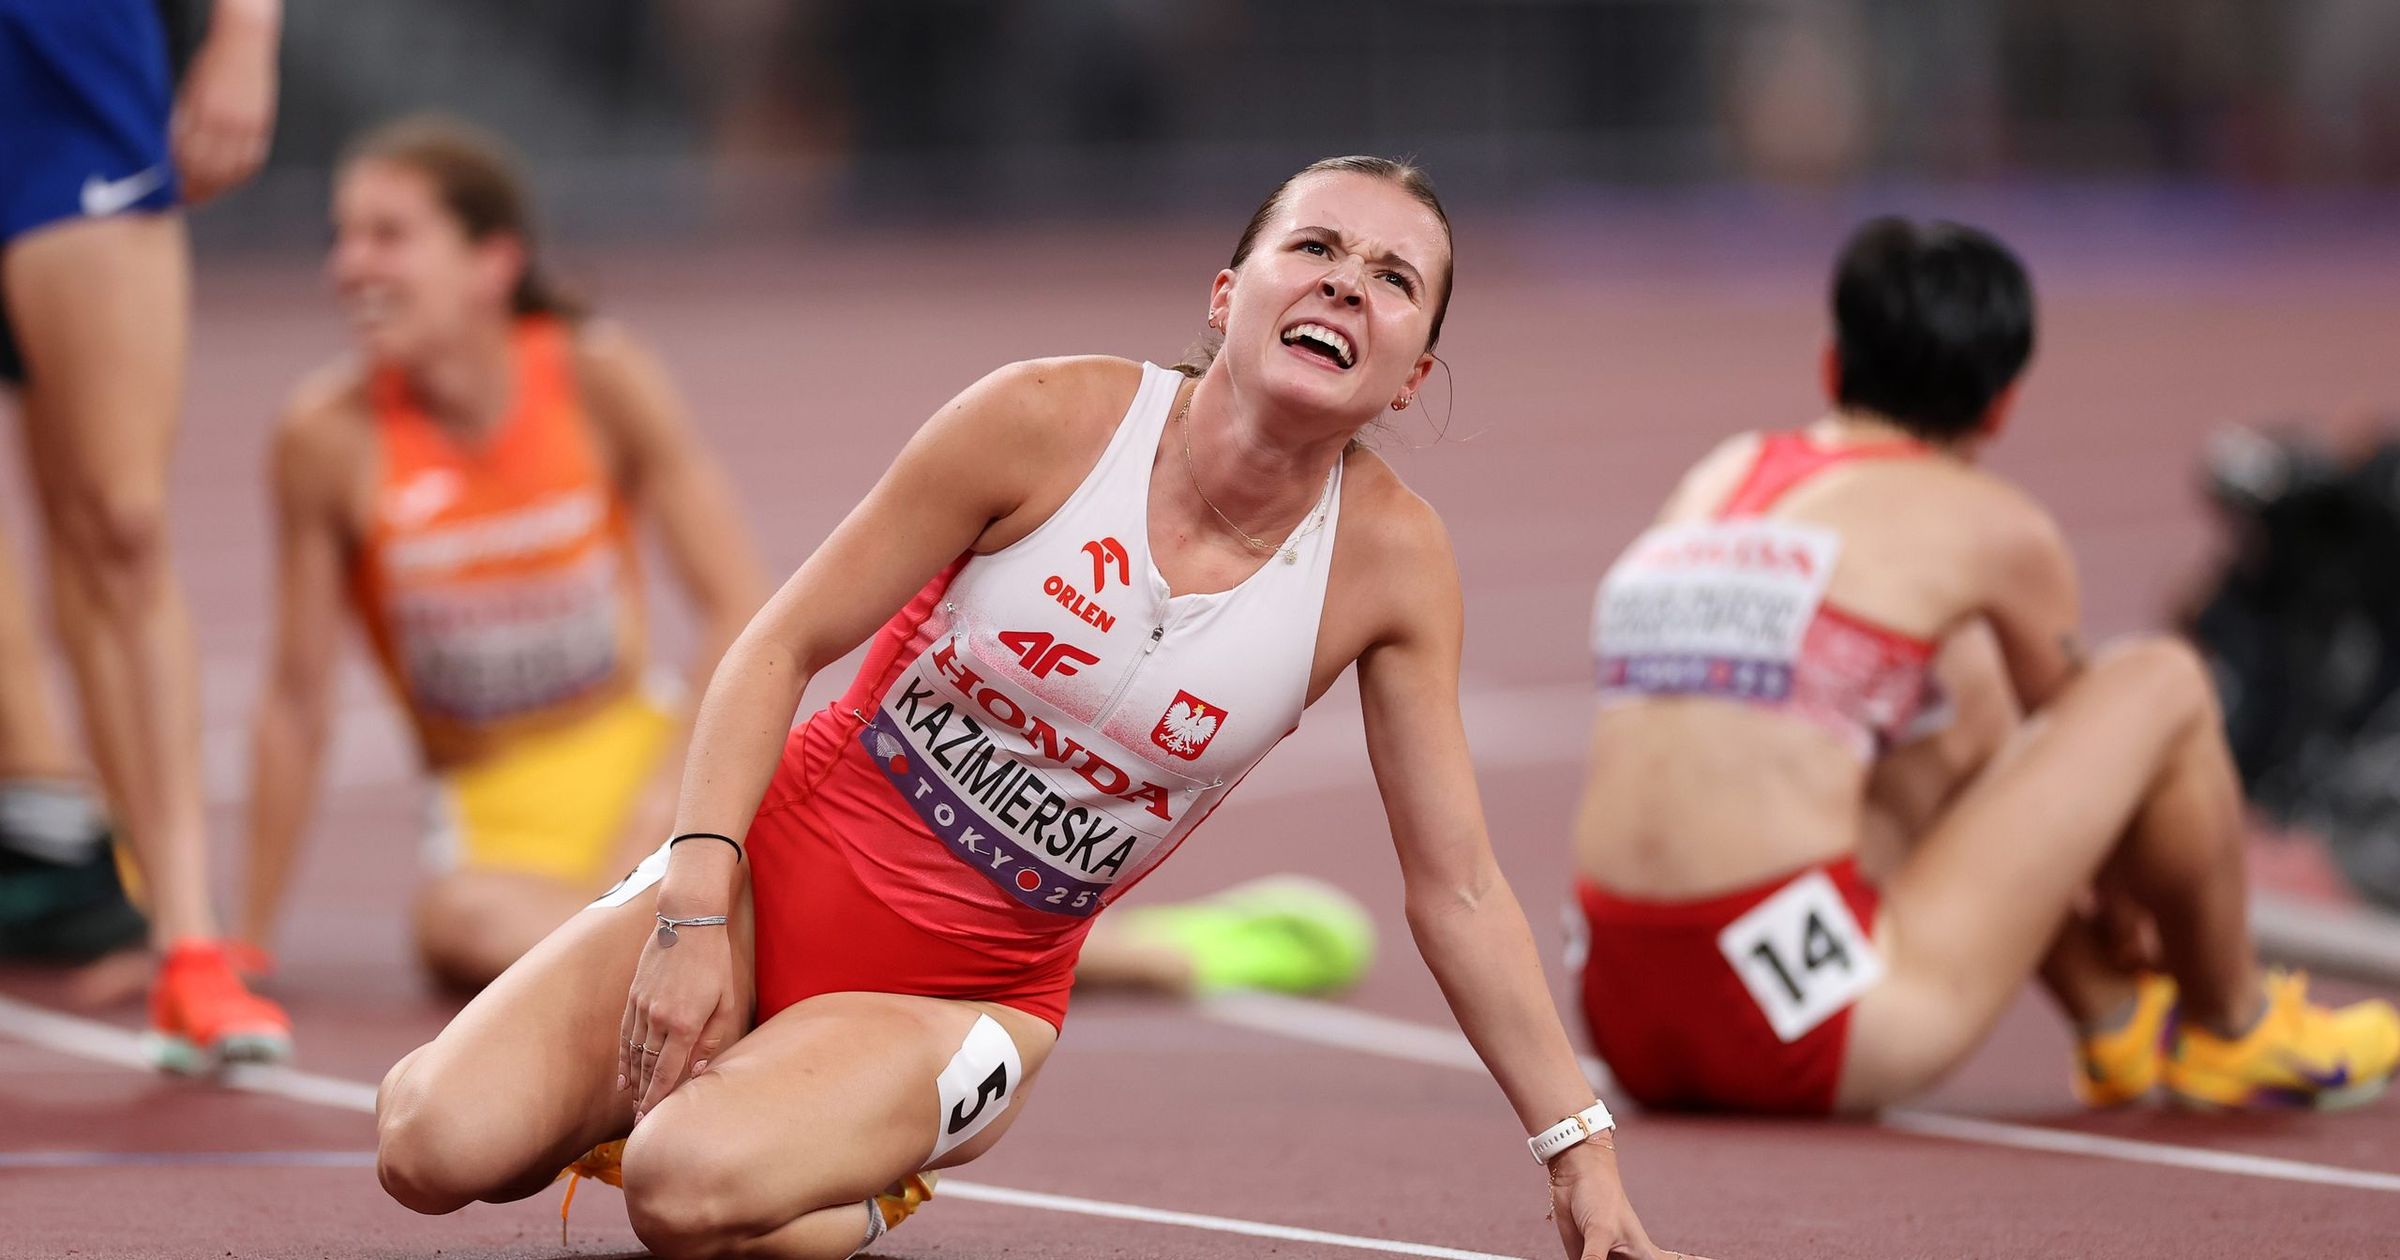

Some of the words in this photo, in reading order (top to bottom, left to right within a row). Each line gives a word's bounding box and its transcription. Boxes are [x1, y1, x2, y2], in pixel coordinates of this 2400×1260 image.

[1043, 575, 1117, 633] ORLEN
[998, 631, 1100, 680] 4F
[932, 636, 1174, 822] HONDA
[895, 676, 1139, 877] KAZIMIERSKA
[1045, 886, 1092, 908] 25
[1751, 910, 1852, 1004] 14
[948, 1061, 1007, 1135] 5
